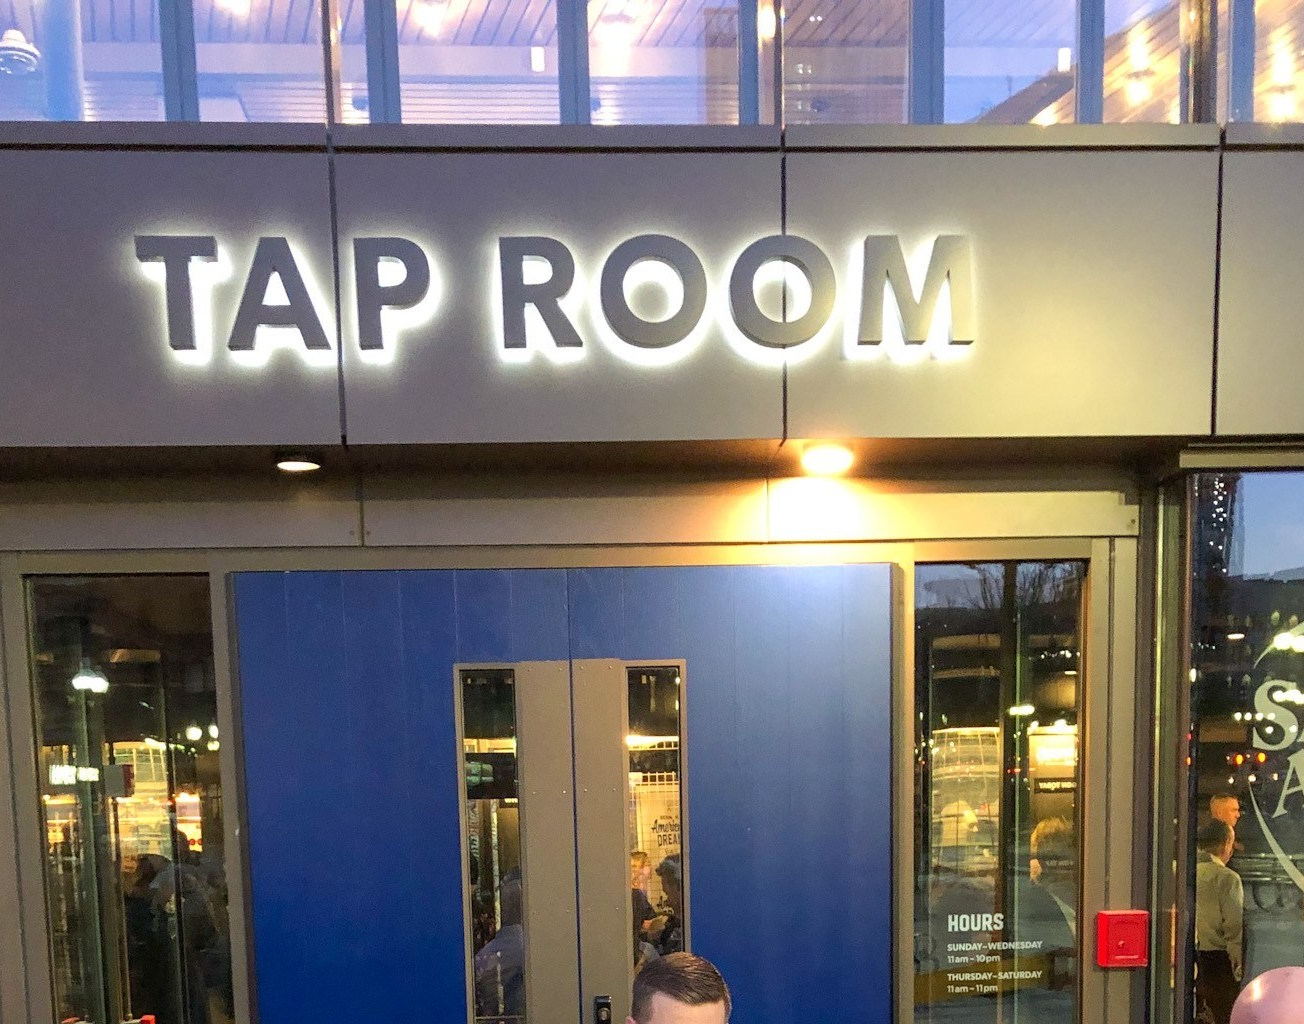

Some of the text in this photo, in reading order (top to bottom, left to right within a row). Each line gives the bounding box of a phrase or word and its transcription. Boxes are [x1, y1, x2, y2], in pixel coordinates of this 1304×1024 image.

[134, 233, 975, 352] TAP ROOM
[657, 834, 680, 847] DREA
[947, 913, 1004, 932] HOURS
[947, 955, 969, 964] 11am
[976, 954, 1001, 964] 10pm
[947, 984, 969, 993] 11am
[976, 984, 998, 993] 11pm
